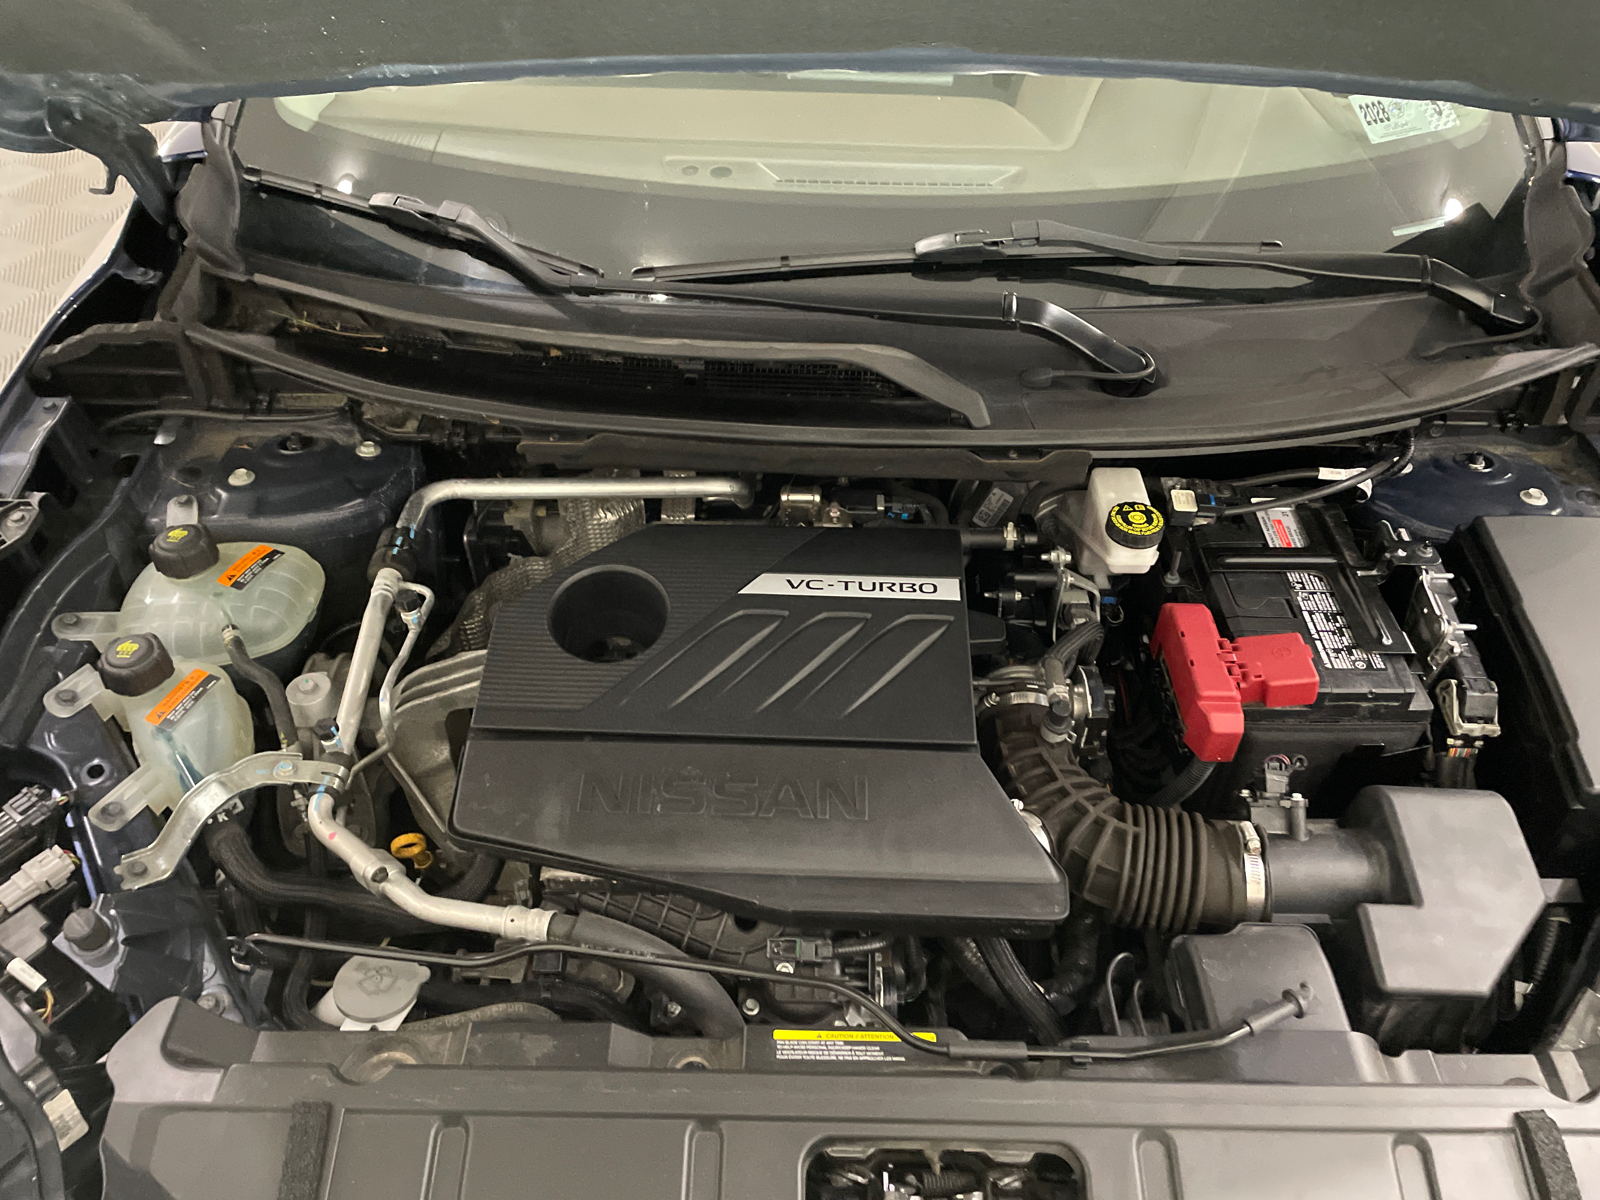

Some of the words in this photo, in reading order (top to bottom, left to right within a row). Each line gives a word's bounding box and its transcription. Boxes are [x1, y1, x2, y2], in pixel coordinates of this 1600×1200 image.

[1358, 100, 1390, 126] 2028
[786, 578, 938, 594] VC-TURBO
[576, 774, 868, 820] NISSAN
